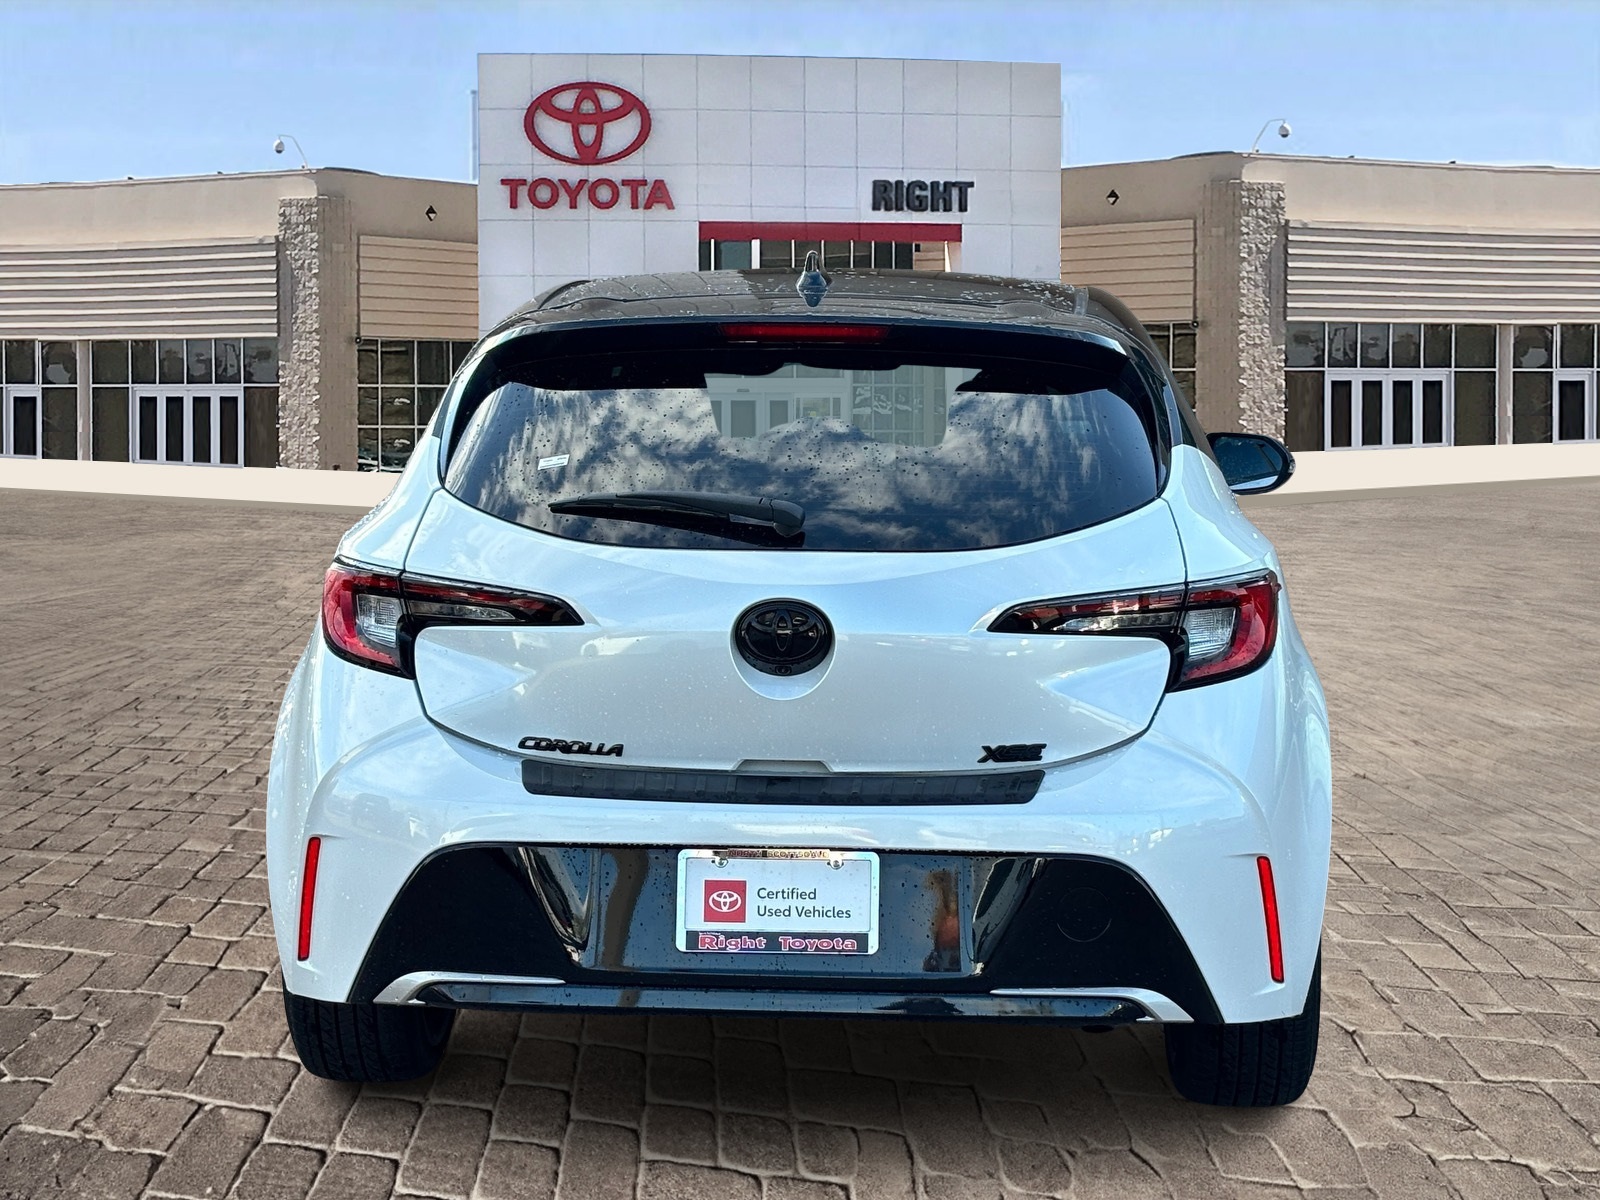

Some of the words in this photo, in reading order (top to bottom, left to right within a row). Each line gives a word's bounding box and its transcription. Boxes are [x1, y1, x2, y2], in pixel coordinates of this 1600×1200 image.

[501, 179, 674, 209] TOYOTA
[872, 179, 974, 212] RIGHT
[518, 736, 624, 757] COROLLA
[977, 743, 1047, 763] XSE
[757, 887, 816, 900] Certified
[757, 905, 791, 917] Used
[795, 906, 851, 918] Vehicles
[698, 935, 767, 951] Right
[779, 936, 857, 949] Toyota
